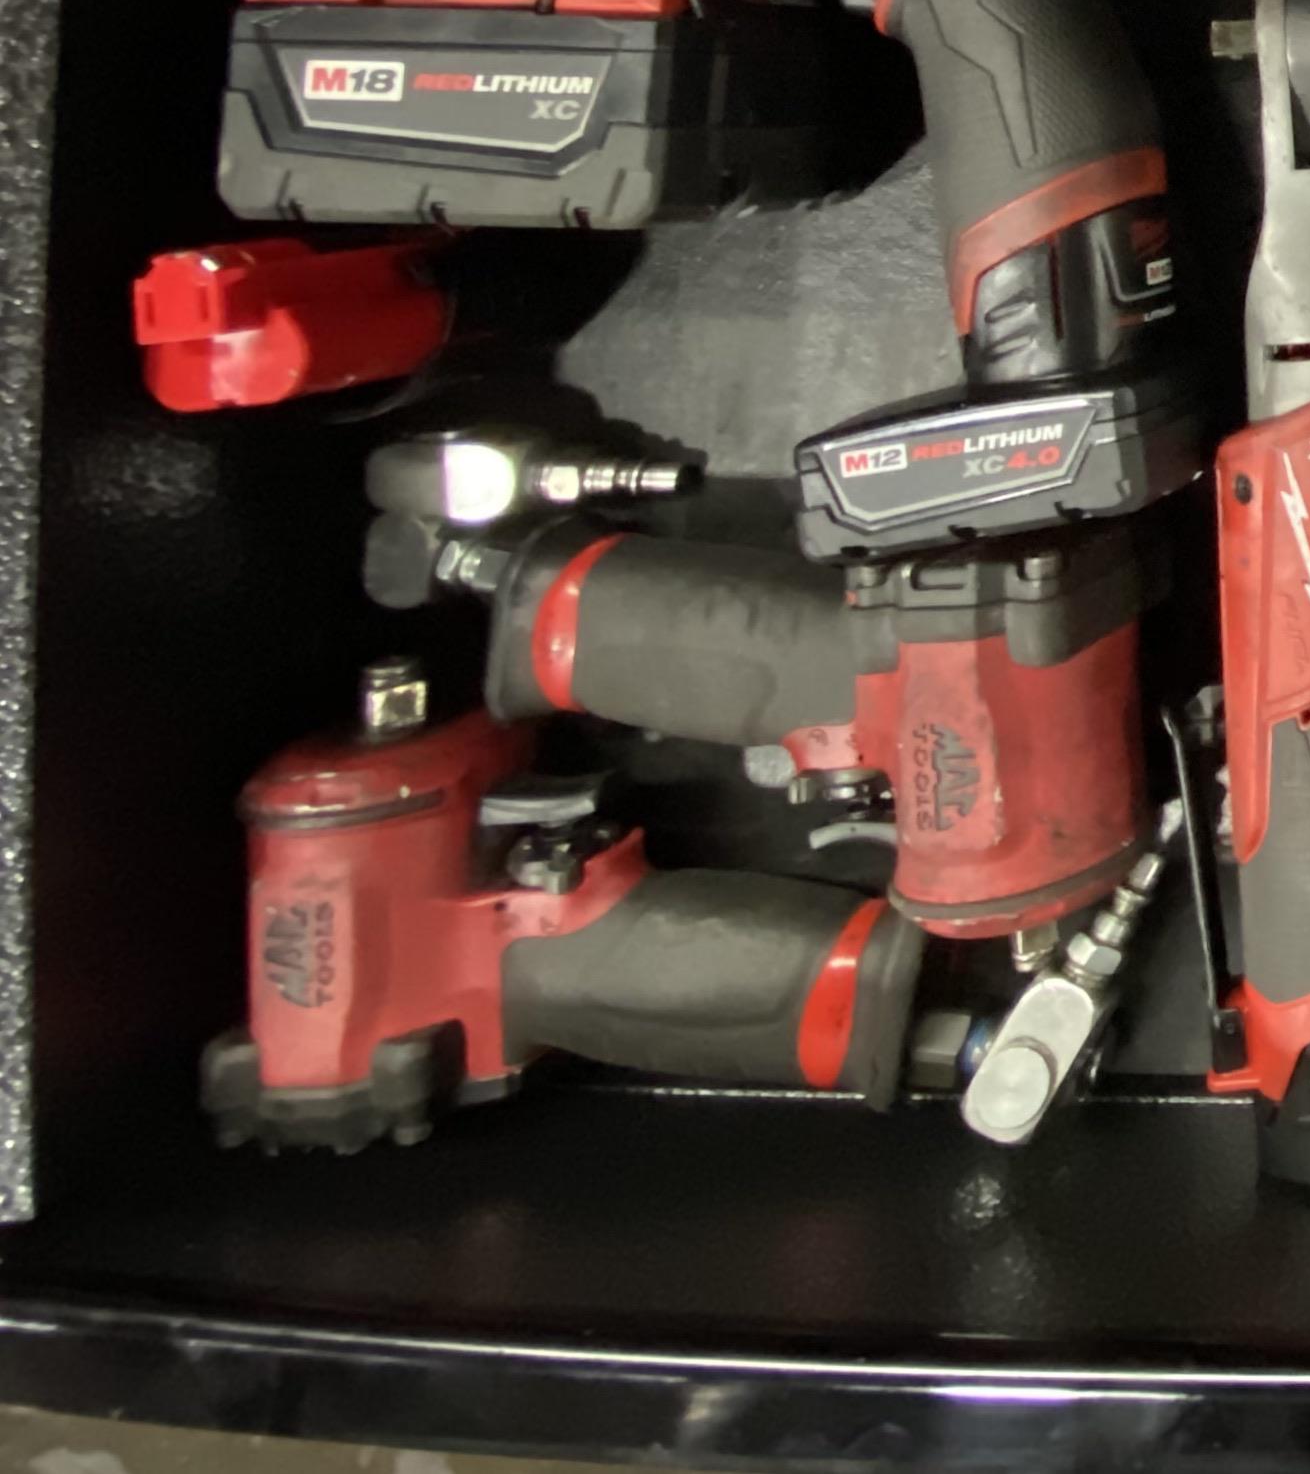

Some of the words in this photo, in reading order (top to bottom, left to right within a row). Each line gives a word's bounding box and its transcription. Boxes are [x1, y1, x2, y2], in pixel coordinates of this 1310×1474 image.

[311, 68, 397, 94] M18
[413, 73, 593, 95] REDLITHIUM
[529, 99, 582, 121] XC
[845, 448, 903, 473] M12
[911, 423, 1063, 462] REDLITHIUM
[912, 722, 934, 830] TOOLS
[929, 724, 981, 831] MAC
[315, 901, 335, 1007] TOOLS
